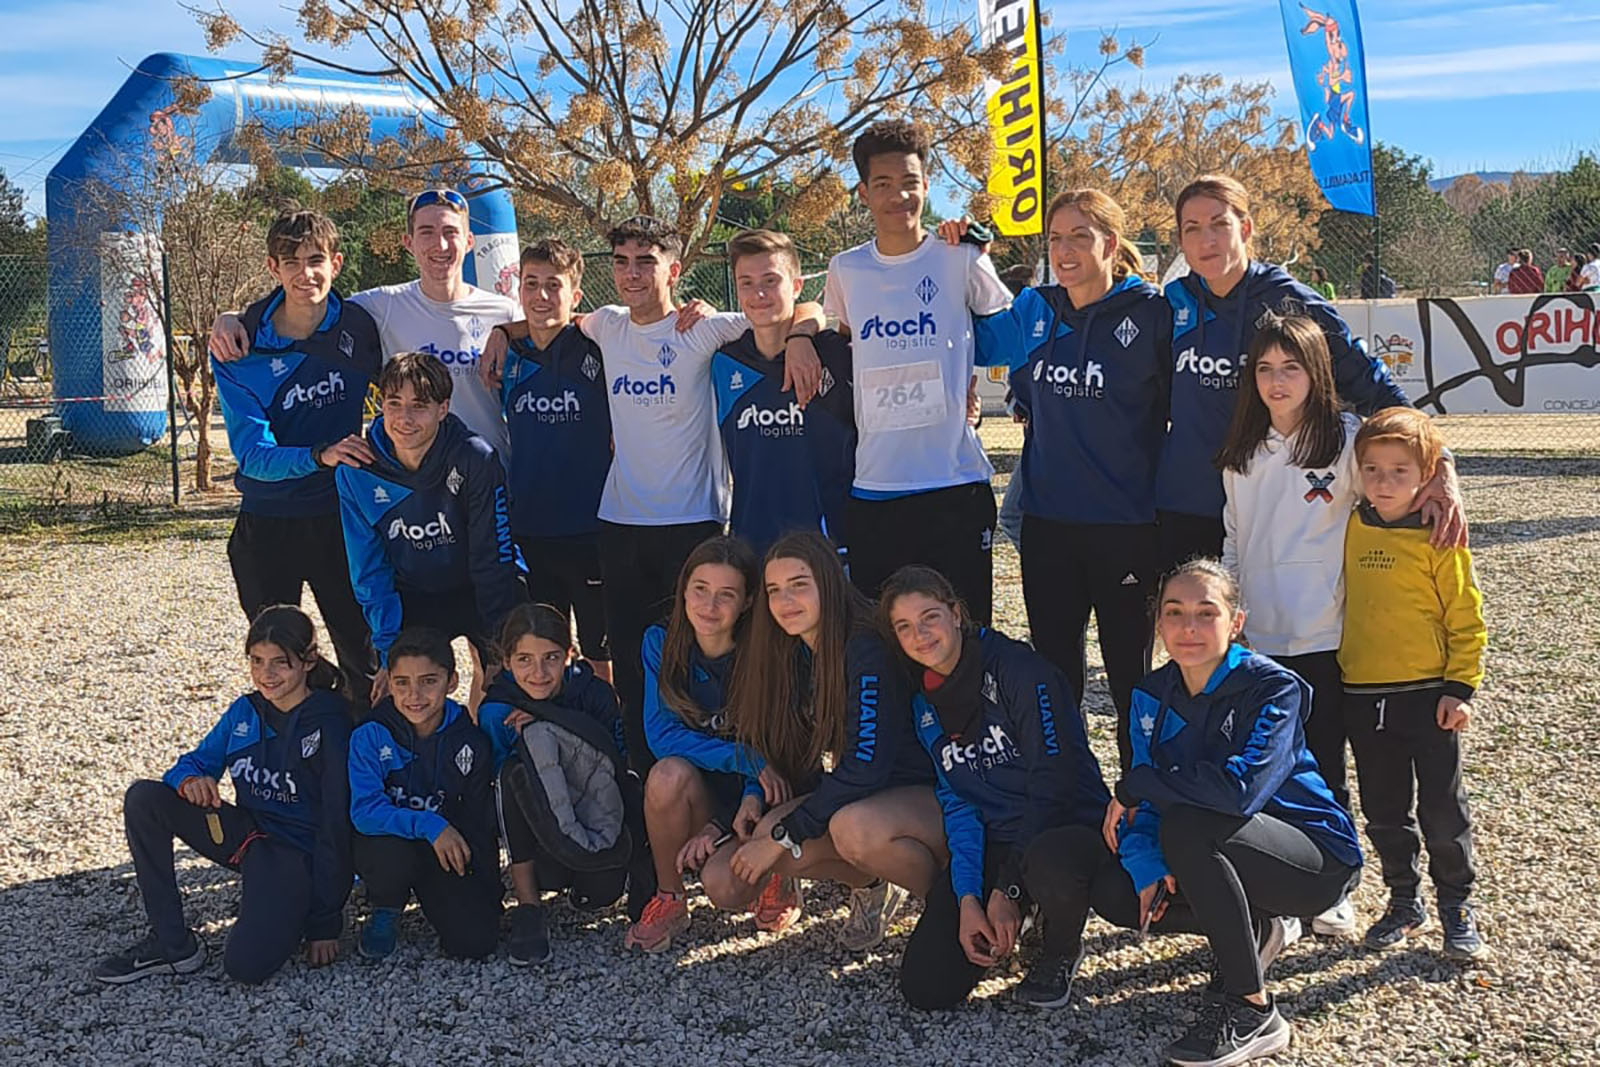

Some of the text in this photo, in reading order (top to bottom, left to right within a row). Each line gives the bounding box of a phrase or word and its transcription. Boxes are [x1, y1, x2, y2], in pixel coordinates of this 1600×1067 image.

[1495, 308, 1600, 355] ORIH
[886, 337, 936, 349] logistic
[876, 381, 926, 409] 264
[1053, 382, 1104, 399] logistic
[632, 396, 676, 407] logistic
[537, 411, 582, 424] logistic
[759, 424, 804, 438] logistic
[494, 485, 513, 563] LUANVI
[412, 534, 457, 551] logistic
[855, 675, 878, 762] LUANVI
[1035, 684, 1061, 756] LUANVI
